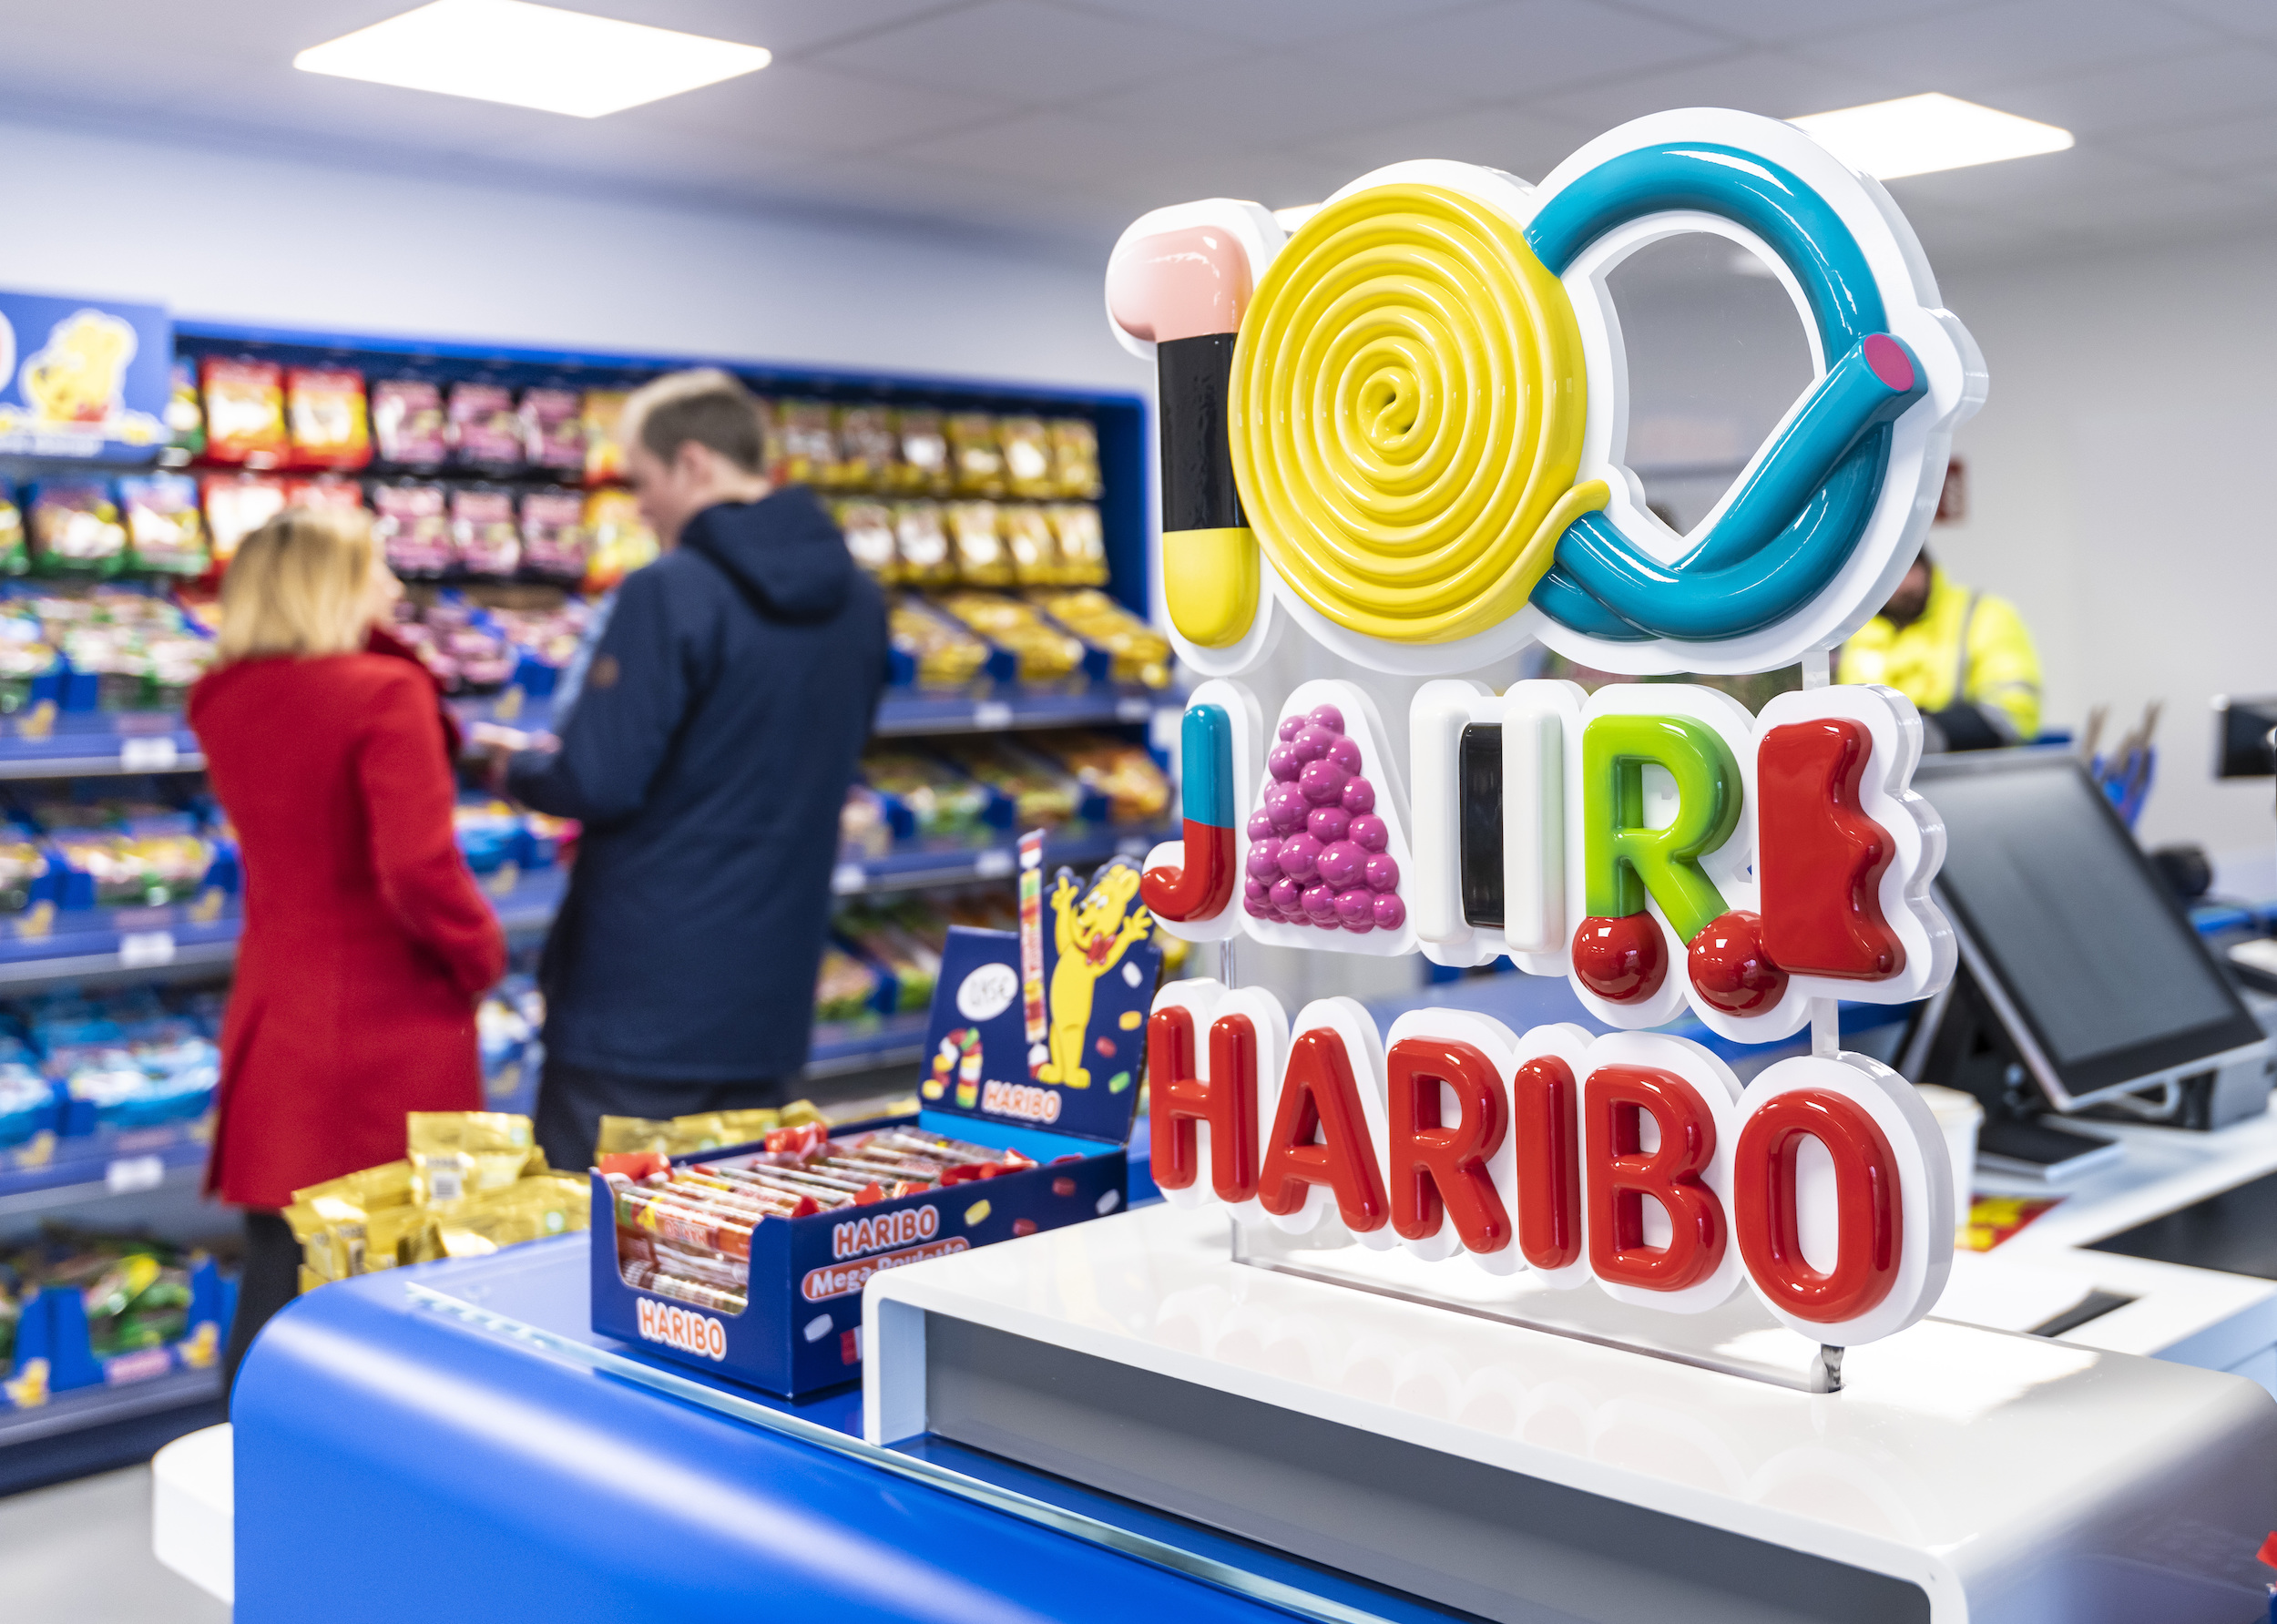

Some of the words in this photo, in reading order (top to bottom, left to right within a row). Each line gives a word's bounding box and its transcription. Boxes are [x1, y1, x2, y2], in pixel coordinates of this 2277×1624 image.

[1108, 140, 1928, 648] 100
[984, 1081, 1059, 1121] HARIBO
[1147, 1005, 1903, 1324] HARIBO
[834, 1207, 937, 1257] HARIBO
[638, 1298, 725, 1359] HARIBO
